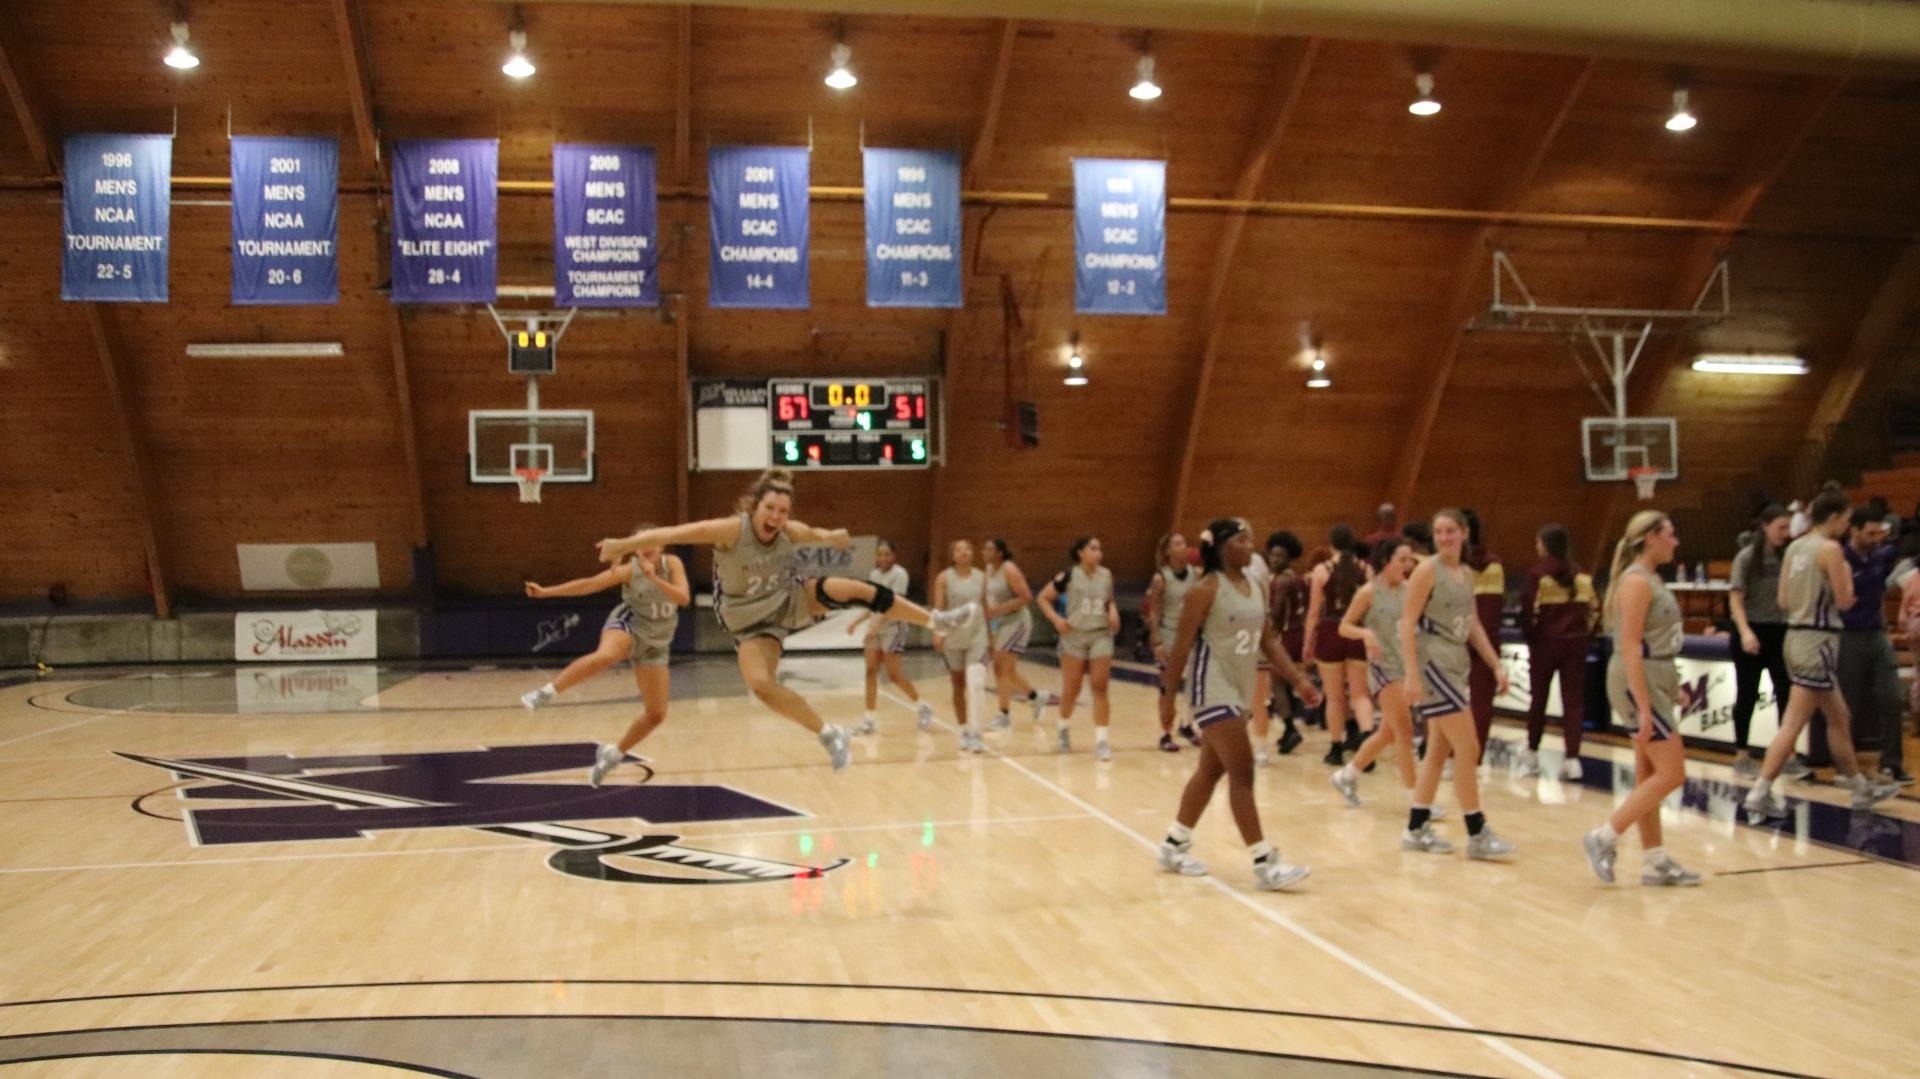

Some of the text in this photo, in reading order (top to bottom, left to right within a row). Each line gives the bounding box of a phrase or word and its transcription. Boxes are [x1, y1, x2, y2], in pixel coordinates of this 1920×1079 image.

[102, 153, 132, 168] 1996
[270, 158, 300, 173] 2001
[95, 180, 137, 195] MEN'S
[264, 186, 305, 201] MEN'S
[424, 186, 465, 201] MEN'S
[585, 182, 625, 198] MEN'S
[739, 193, 780, 209] MEN'S
[95, 207, 136, 222] NCAA
[265, 213, 304, 228] NCAA
[424, 213, 464, 229] NCAA
[586, 209, 624, 225] SCAC
[741, 220, 777, 236] SCAC
[896, 219, 931, 235] SCAC
[67, 235, 162, 251] TOURNAMENT
[238, 241, 331, 256] TOURNAMENT
[565, 236, 647, 249] WEST DIVISION
[573, 250, 640, 262] CHAMPIONS
[720, 246, 798, 263] CHAMPIONS
[876, 244, 952, 261] CHAMPIONS
[568, 271, 645, 284] TOURNAMENT
[573, 285, 640, 298] CHAMPIONS
[828, 384, 869, 408] 0.0
[779, 396, 808, 420] 67
[895, 395, 924, 419] 51
